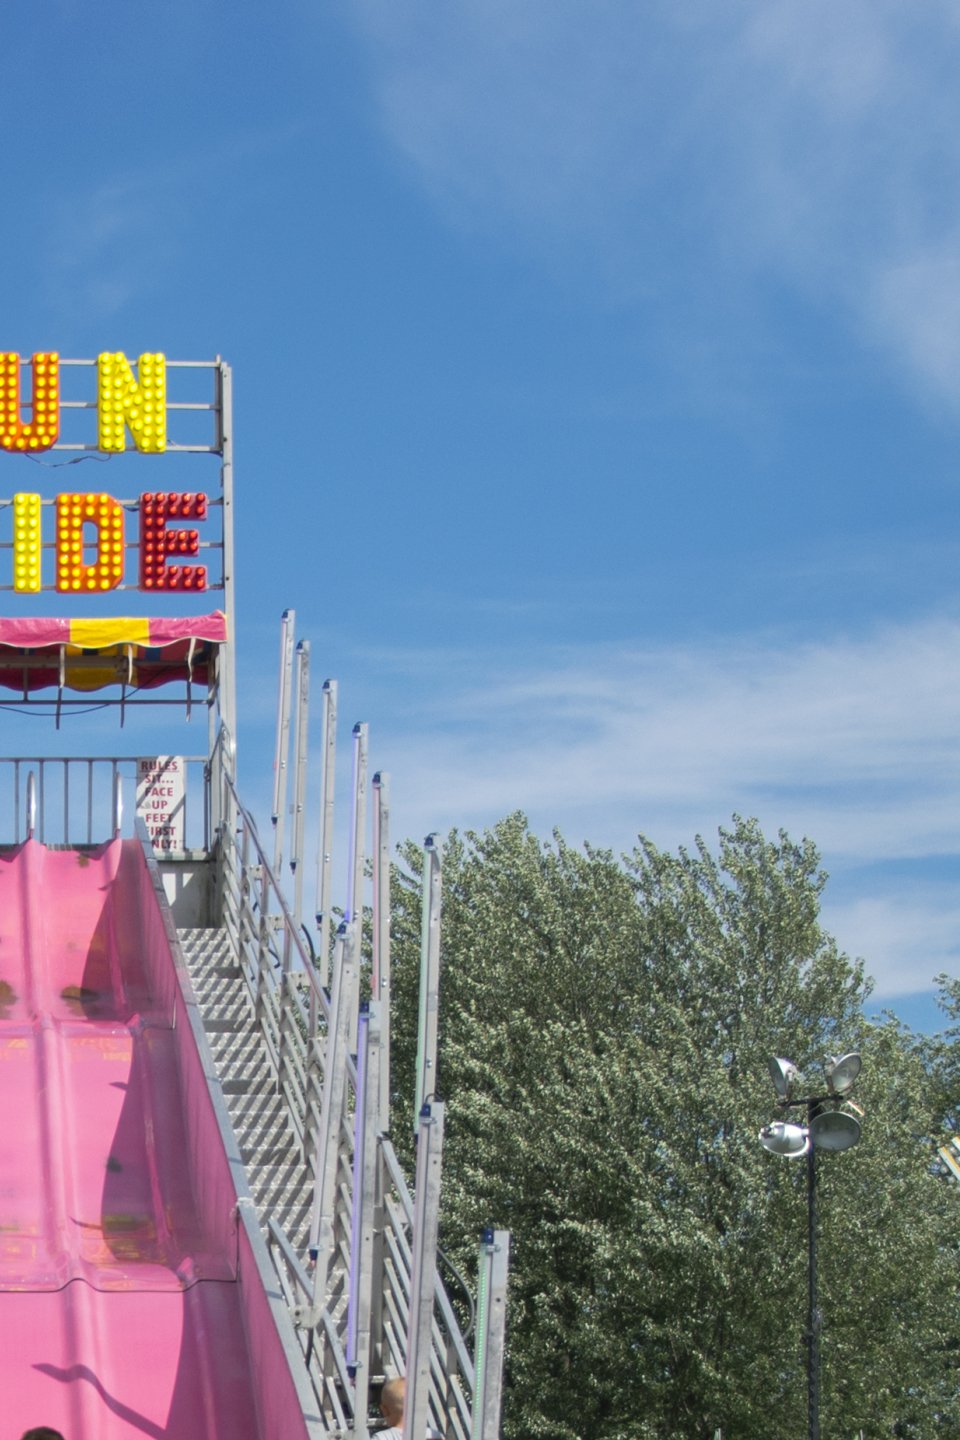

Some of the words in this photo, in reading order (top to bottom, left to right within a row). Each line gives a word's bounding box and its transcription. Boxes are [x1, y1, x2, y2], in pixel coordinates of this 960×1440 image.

[141, 761, 178, 771] RULES
[145, 774, 174, 783] SIT...
[145, 787, 173, 796] FACE
[152, 800, 168, 809] UP
[145, 814, 174, 822] FEET
[151, 839, 177, 849] NLY!
